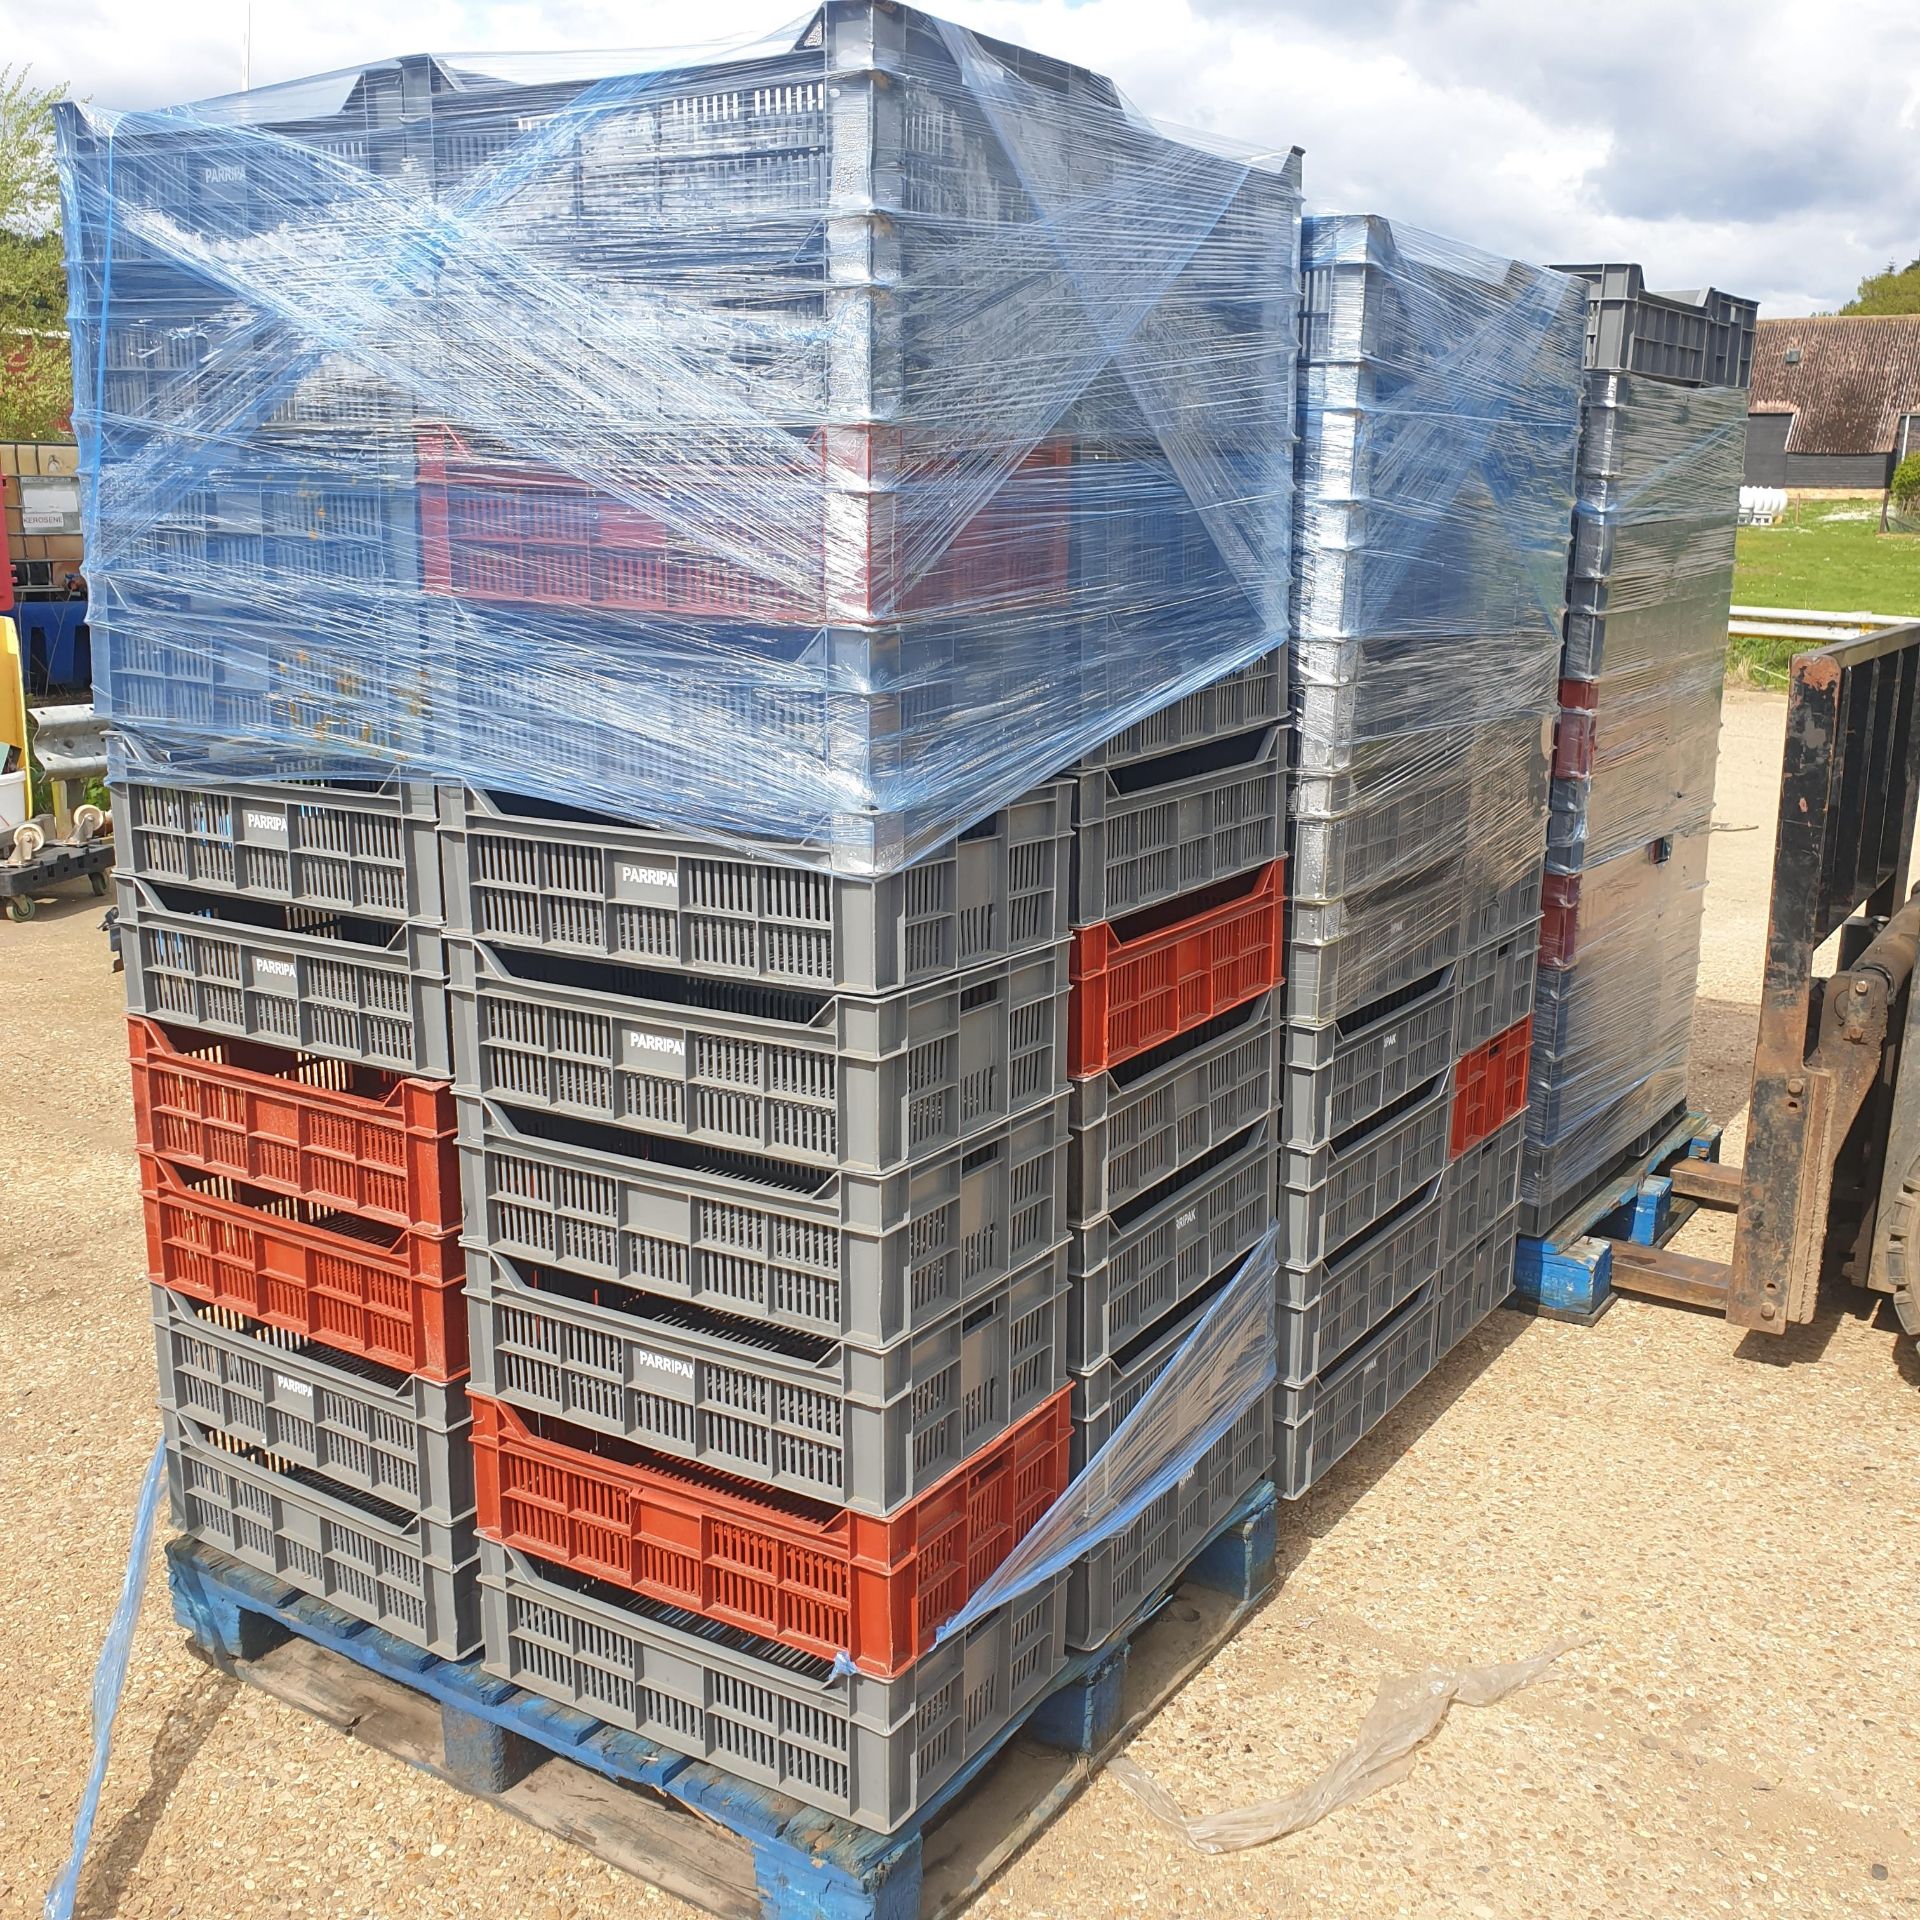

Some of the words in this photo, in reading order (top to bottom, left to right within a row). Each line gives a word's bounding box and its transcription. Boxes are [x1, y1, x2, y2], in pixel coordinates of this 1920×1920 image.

[205, 165, 246, 183] PARRIPA
[23, 516, 63, 524] KEROSENE
[247, 813, 287, 832] PARRIPA
[256, 958, 296, 978] PARRIPA
[277, 1374, 313, 1398] PARRIPA
